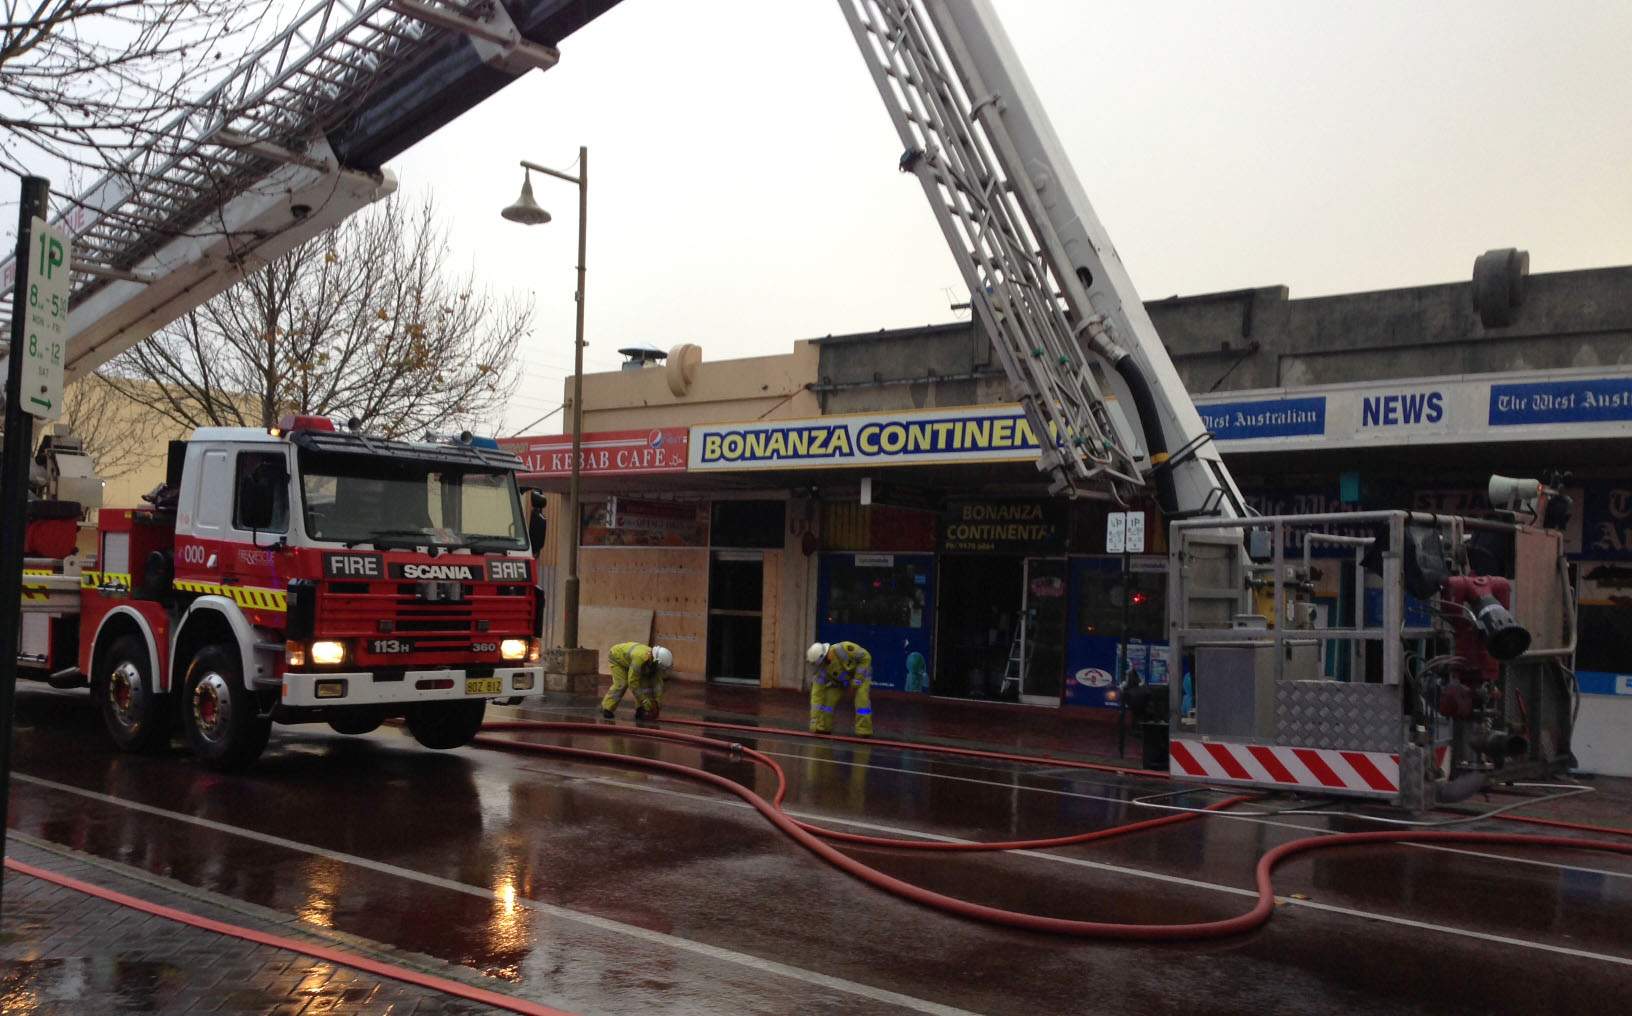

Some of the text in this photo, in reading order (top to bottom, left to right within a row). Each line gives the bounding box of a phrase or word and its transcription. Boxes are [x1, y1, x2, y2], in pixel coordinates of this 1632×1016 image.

[40, 233, 64, 279] 1P
[1362, 390, 1444, 427] NEWS
[1532, 391, 1576, 411] West
[1234, 407, 1318, 427] Australian
[703, 427, 850, 461] BONANZA
[551, 450, 609, 471] KEBAB
[961, 504, 1043, 520] BONANZA
[184, 544, 205, 564] 000
[330, 556, 379, 576] FIRE
[403, 564, 473, 580] SCANIA
[472, 642, 496, 652] 360
